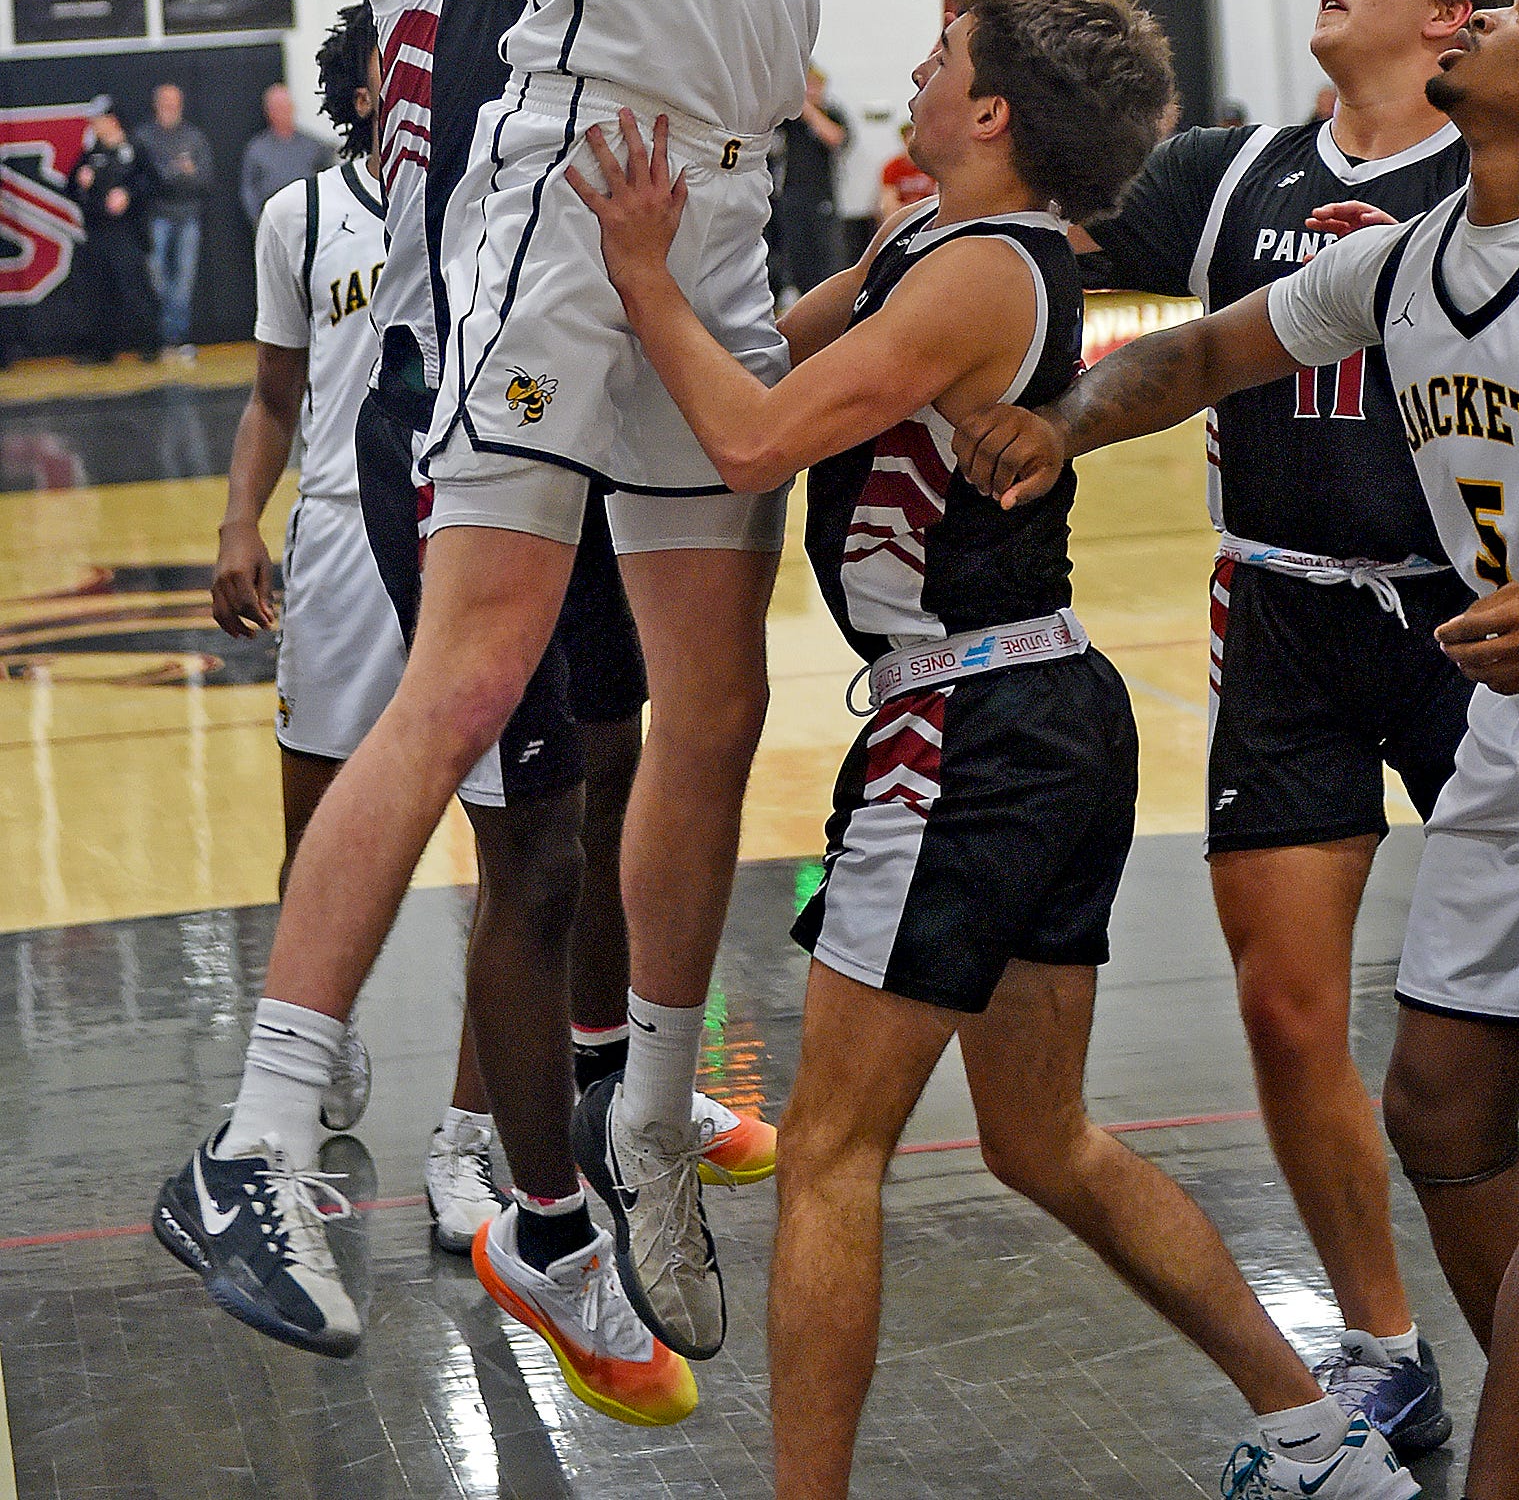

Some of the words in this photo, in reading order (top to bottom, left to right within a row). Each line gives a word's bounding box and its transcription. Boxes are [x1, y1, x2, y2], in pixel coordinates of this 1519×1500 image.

[1253, 228, 1339, 263] PANT
[1399, 373, 1519, 453] JACKE
[1455, 476, 1512, 590] 5
[1002, 632, 1052, 656] FUTURE
[911, 652, 956, 676] ONES
